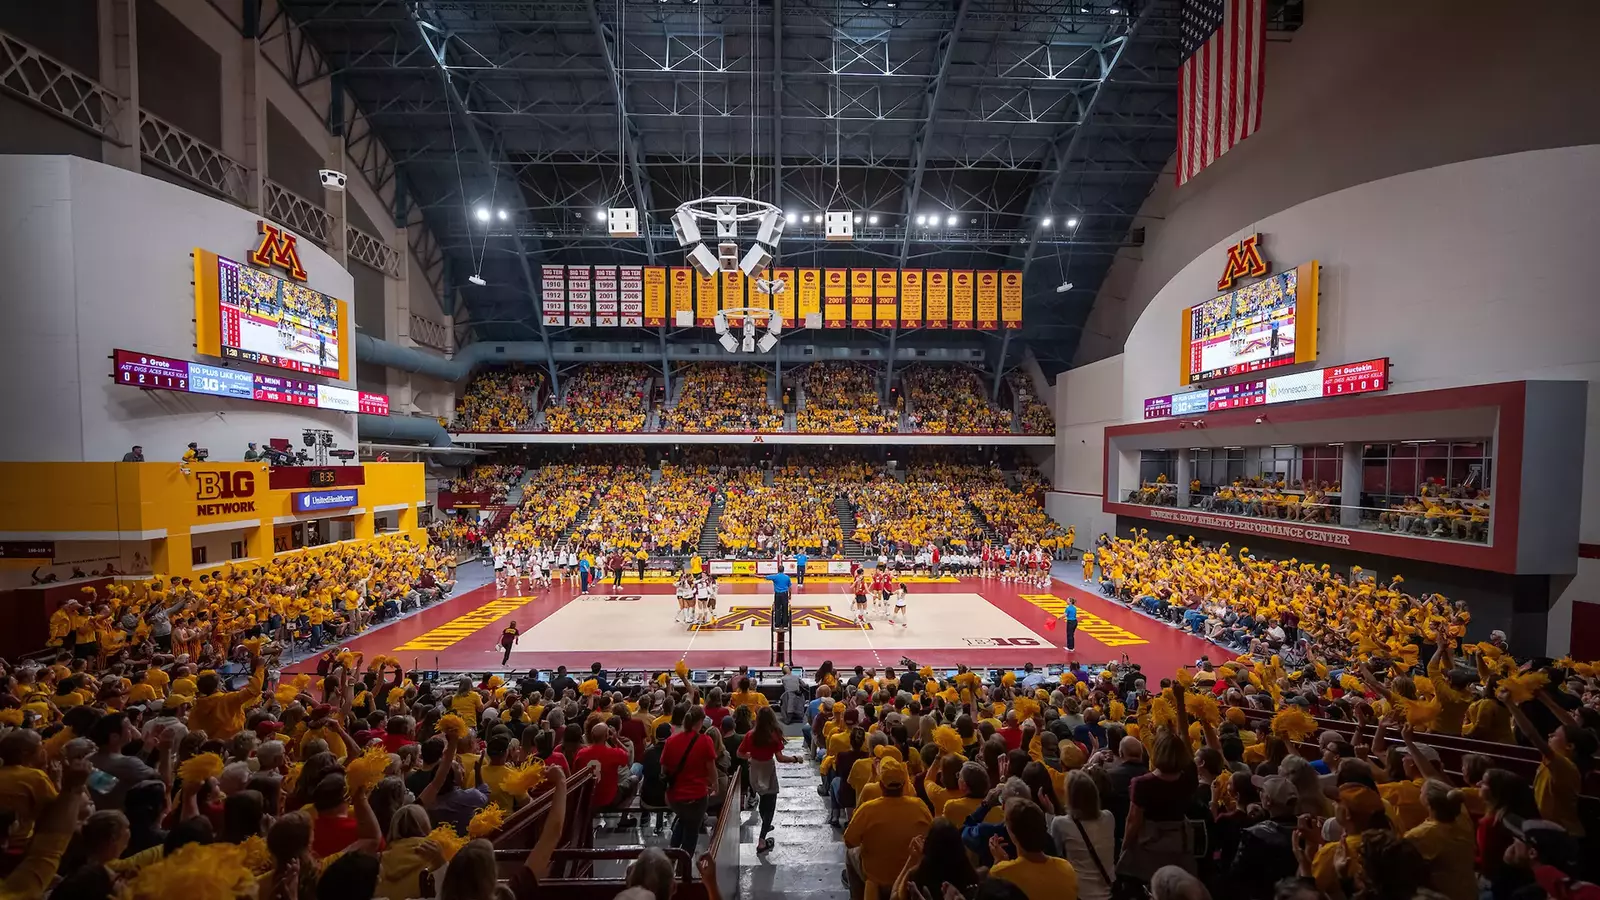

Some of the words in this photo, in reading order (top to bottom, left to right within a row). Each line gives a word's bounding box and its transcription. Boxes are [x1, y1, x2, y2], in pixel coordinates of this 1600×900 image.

[253, 224, 308, 282] M
[1218, 234, 1267, 291] M
[150, 359, 170, 368] Grote
[202, 368, 218, 377] PLUS
[1344, 364, 1372, 374] Guctekin
[124, 372, 130, 381] 0
[139, 374, 145, 383] 2
[155, 376, 158, 384] 1
[168, 378, 172, 386] 1
[180, 380, 185, 388] 2
[265, 377, 280, 385] MINN
[1361, 381, 1366, 389] 0
[1374, 379, 1379, 387] 0
[1278, 385, 1307, 394] Minnesota
[320, 472, 335, 481] 8:35
[312, 494, 354, 504] UnitedHealthcare
[197, 501, 255, 516] NETWORK
[1151, 510, 1173, 520] ROBERT
[1180, 514, 1197, 523] EDDY
[1198, 516, 1233, 527] ATHLETIC
[1235, 520, 1303, 538] PERFORMANCE
[1305, 530, 1350, 545] CENTER
